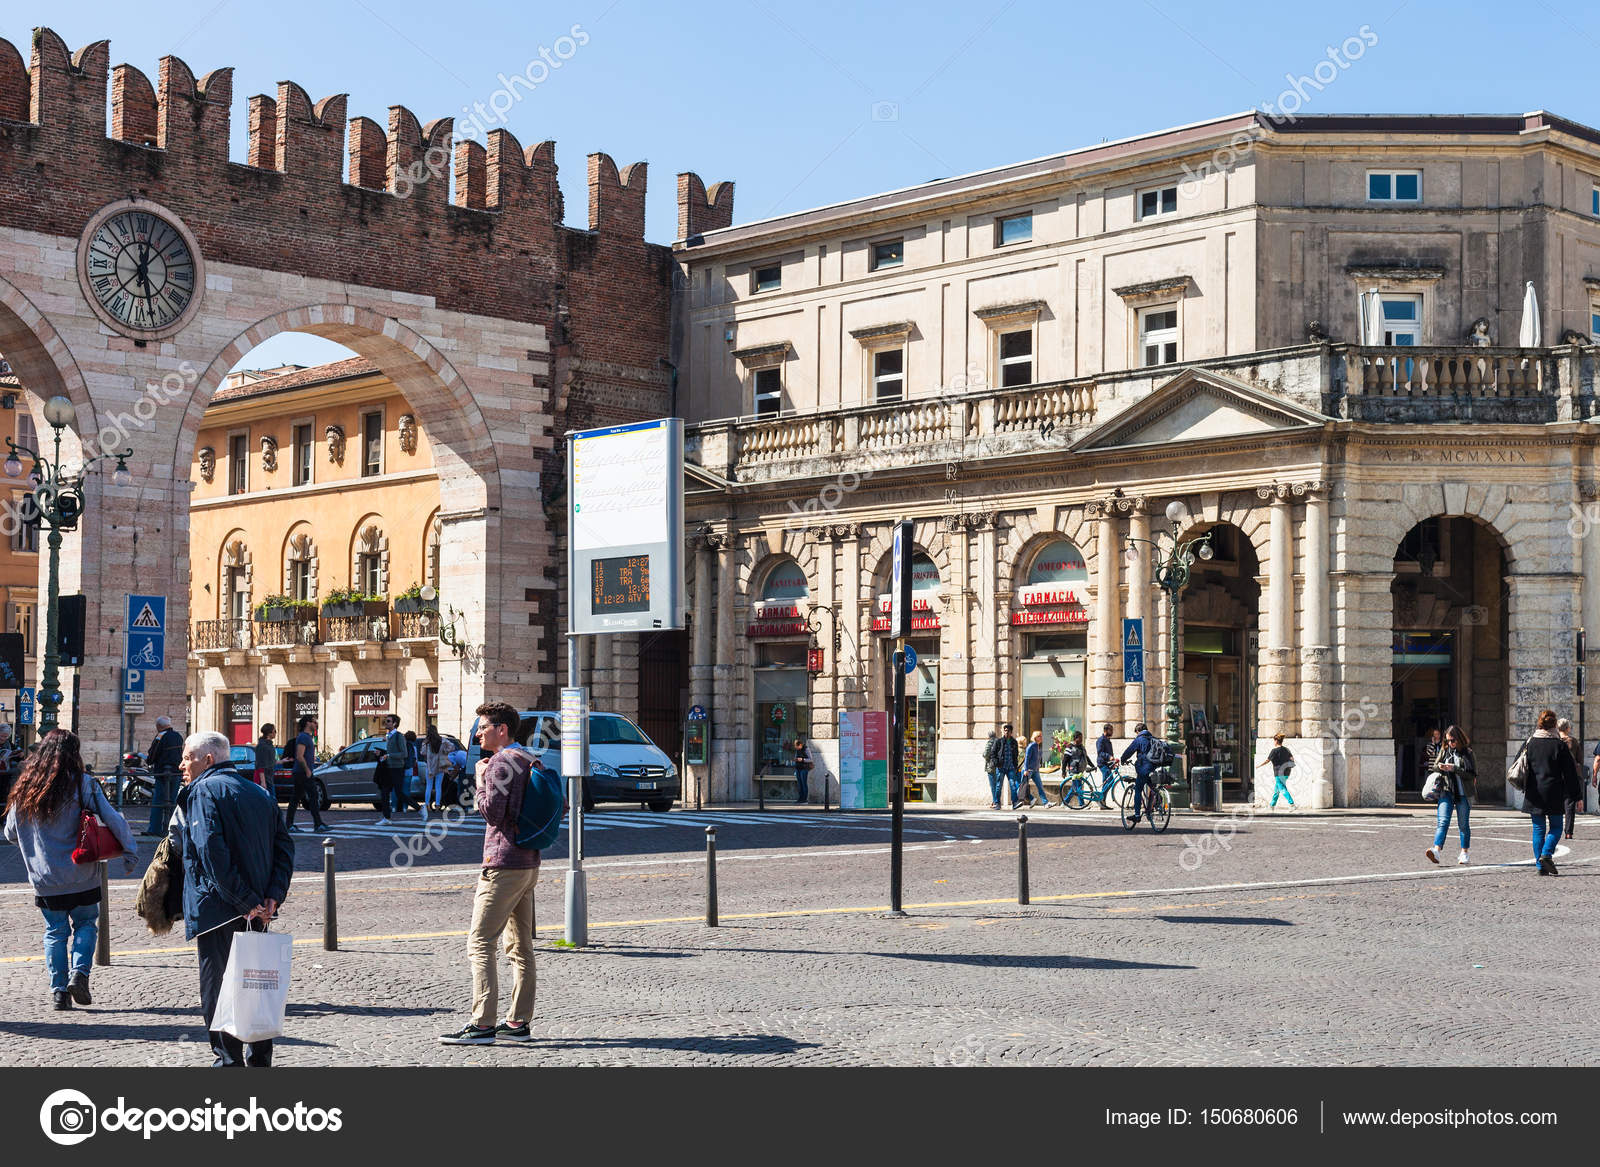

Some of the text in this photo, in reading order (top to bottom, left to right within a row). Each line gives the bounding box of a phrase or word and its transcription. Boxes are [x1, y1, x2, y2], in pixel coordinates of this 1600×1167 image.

[1440, 450, 1526, 463] MCMXXIX
[1024, 591, 1077, 605] FARMACIA
[757, 606, 799, 619] FARMACIA
[882, 599, 929, 613] FACIA
[1012, 608, 1088, 626] INTERNAZIONALE
[127, 669, 141, 690] P
[359, 692, 386, 709] pretto
